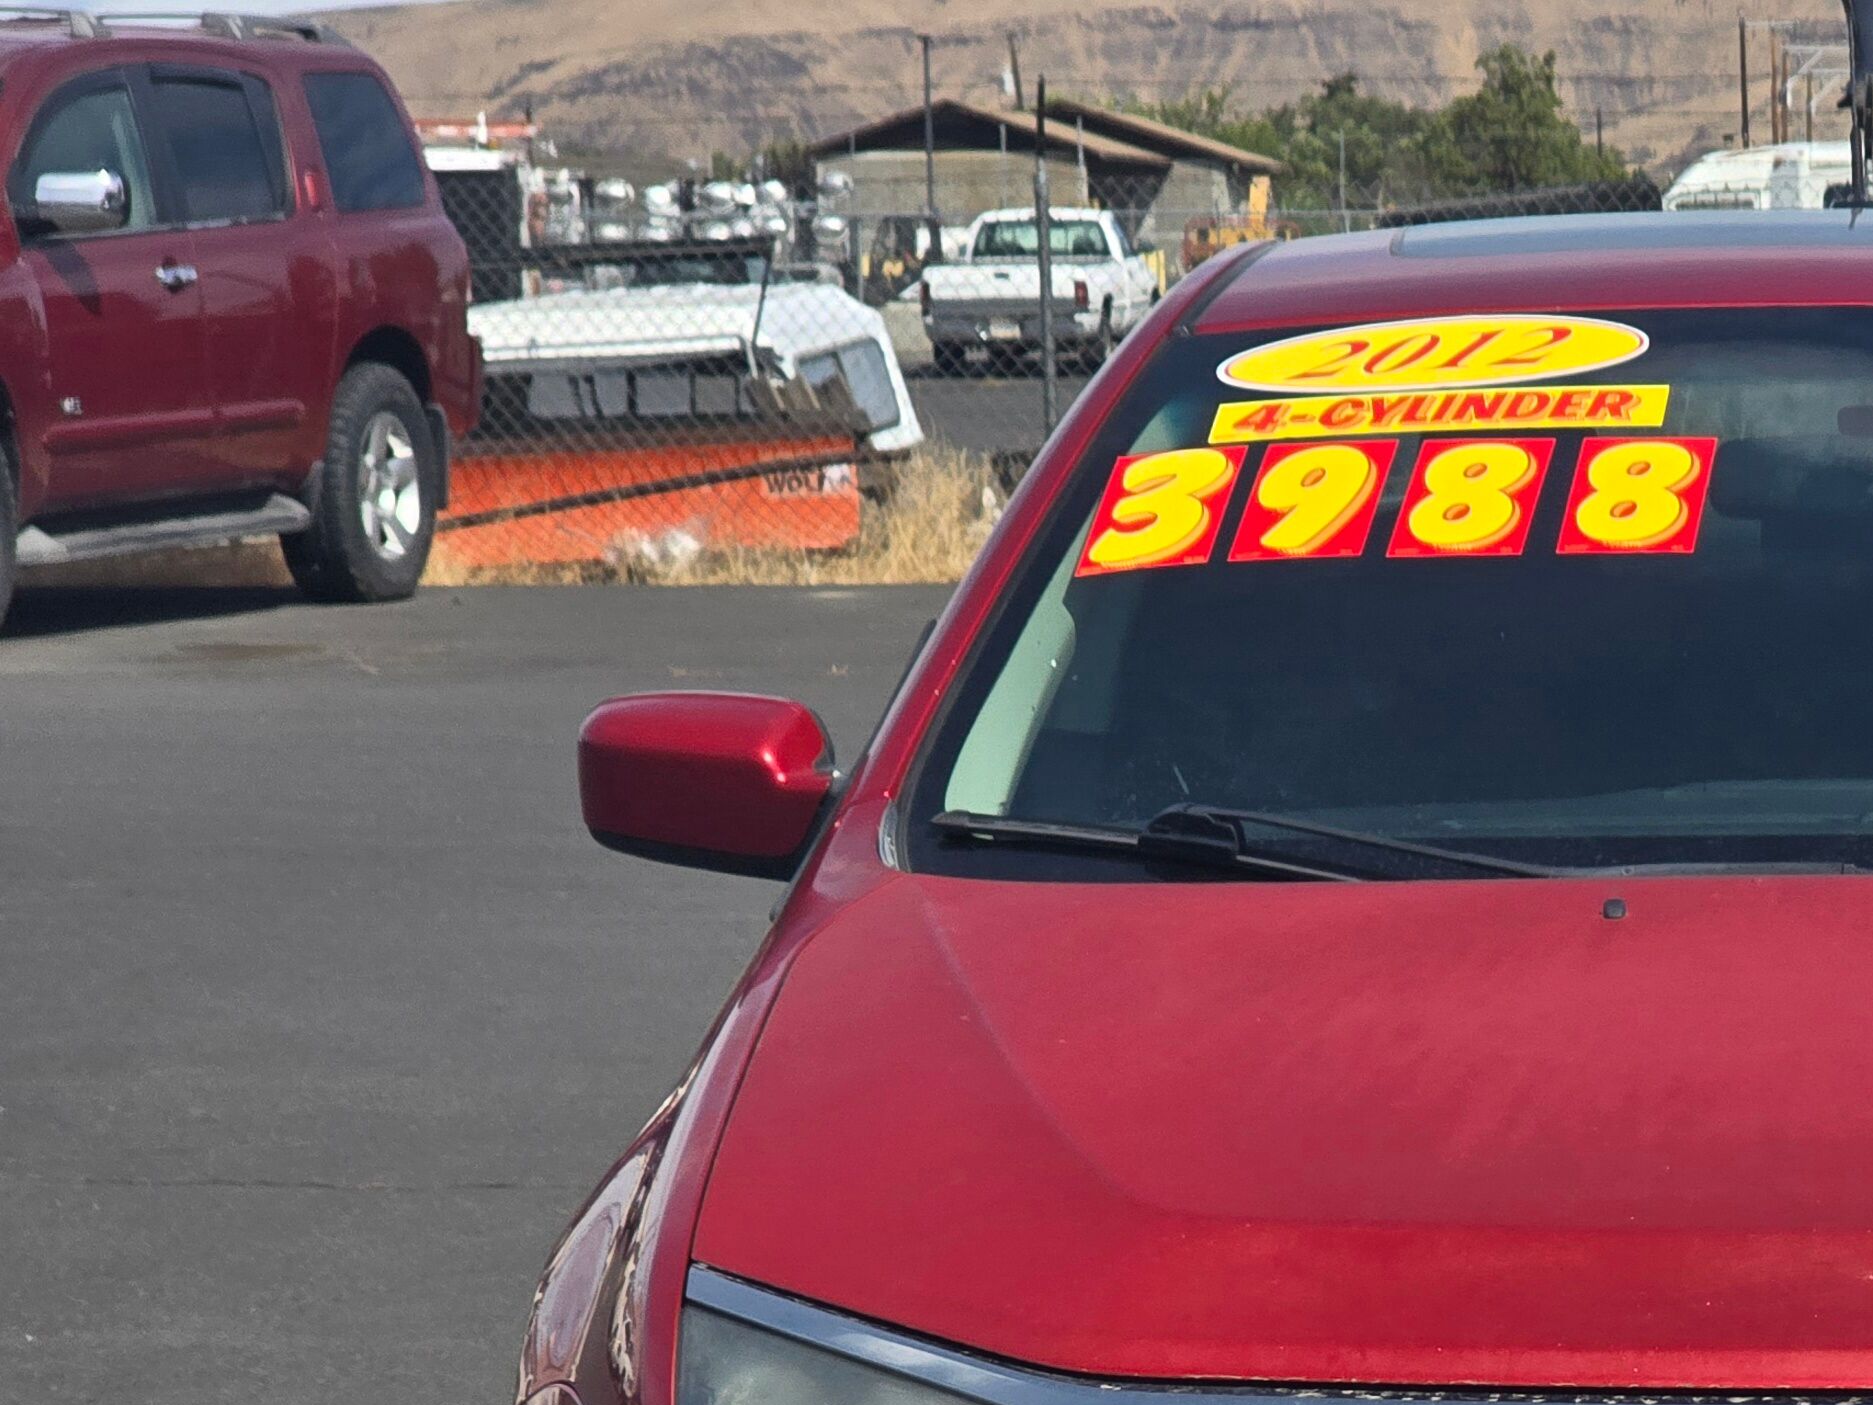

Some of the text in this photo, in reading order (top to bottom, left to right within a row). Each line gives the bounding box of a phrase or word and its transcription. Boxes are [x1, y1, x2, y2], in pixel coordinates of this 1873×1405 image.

[1288, 326, 1572, 380] 2012
[1232, 390, 1640, 433] 4-CYLINDER
[1088, 442, 1700, 564] 3988
